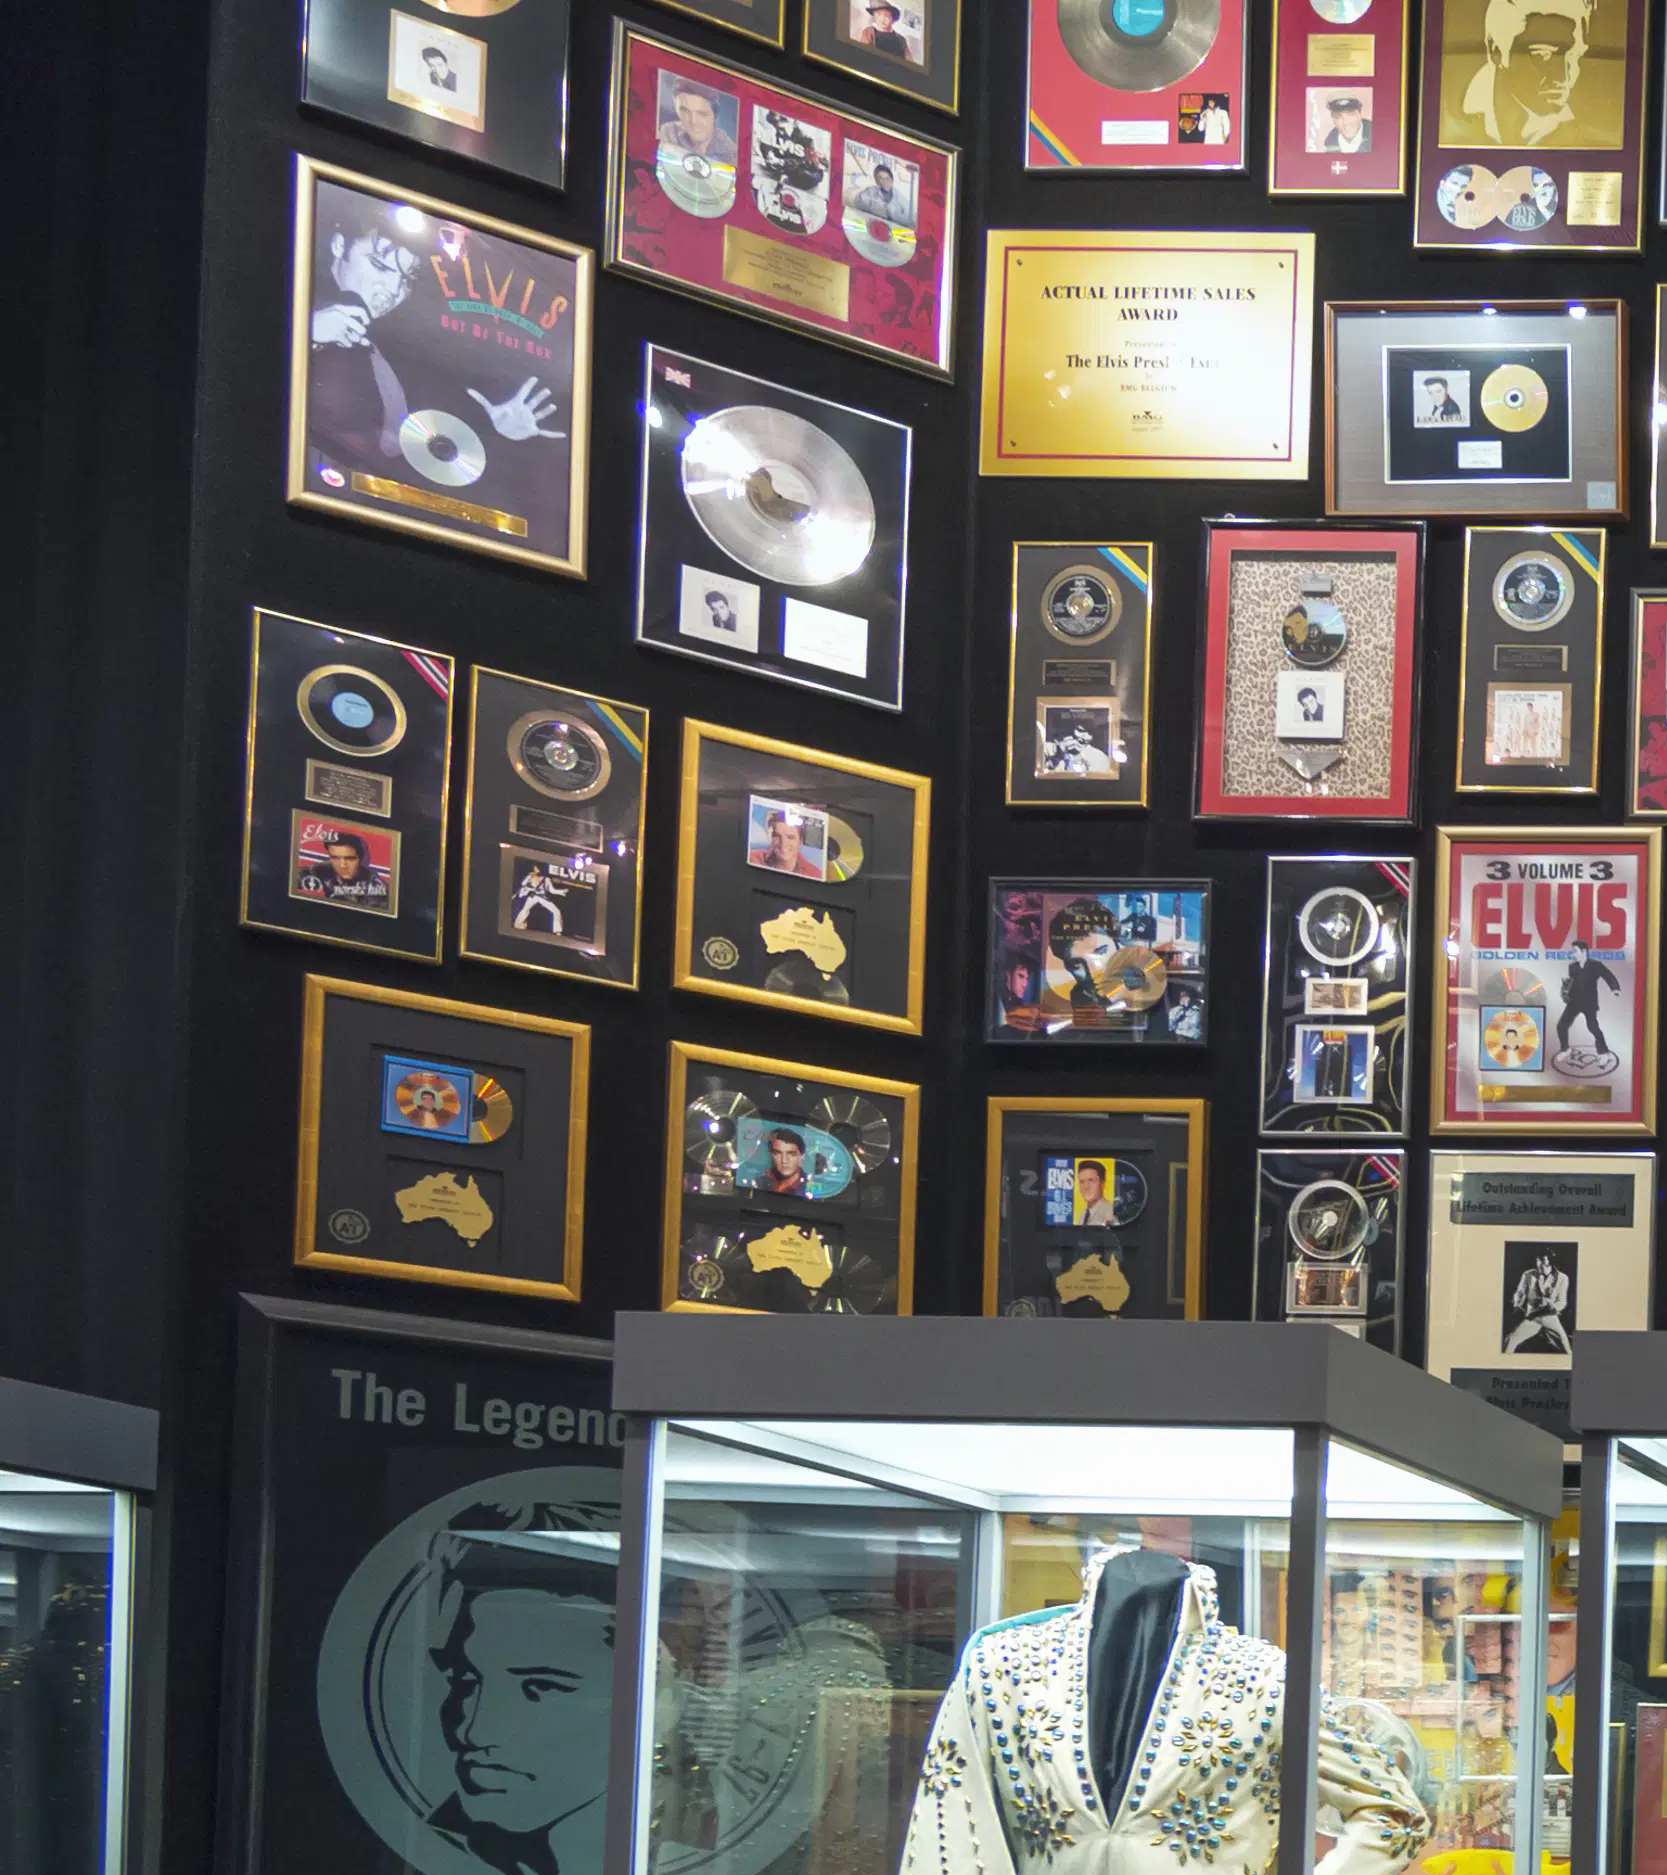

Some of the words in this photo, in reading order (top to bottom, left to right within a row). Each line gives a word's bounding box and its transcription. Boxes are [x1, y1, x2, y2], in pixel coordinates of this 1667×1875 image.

[430, 254, 568, 331] ELVIS
[1040, 285, 1108, 301] ACTUAL
[1113, 285, 1197, 302] LIFETIME
[1202, 286, 1257, 302] SALES
[1117, 307, 1179, 322] AWARD
[1066, 355, 1093, 369] The
[1096, 355, 1130, 369] Elvis
[301, 822, 340, 845] Elvis
[548, 863, 597, 884] ELVIS
[1486, 861, 1512, 881] 3
[1518, 863, 1584, 880] VOLUME
[1589, 861, 1615, 881] 3
[1470, 883, 1628, 950] ELVIS
[1545, 950, 1626, 962] RECRDS
[1047, 1168, 1074, 1190] ELVIS
[1482, 1181, 1554, 1198] Outstanding
[1558, 1182, 1603, 1197] Overall
[1456, 1200, 1505, 1214] Lifetime
[1509, 1202, 1585, 1216] Achievement
[1589, 1204, 1628, 1217] Award
[1491, 1376, 1559, 1390] Presented
[332, 1368, 426, 1429] The
